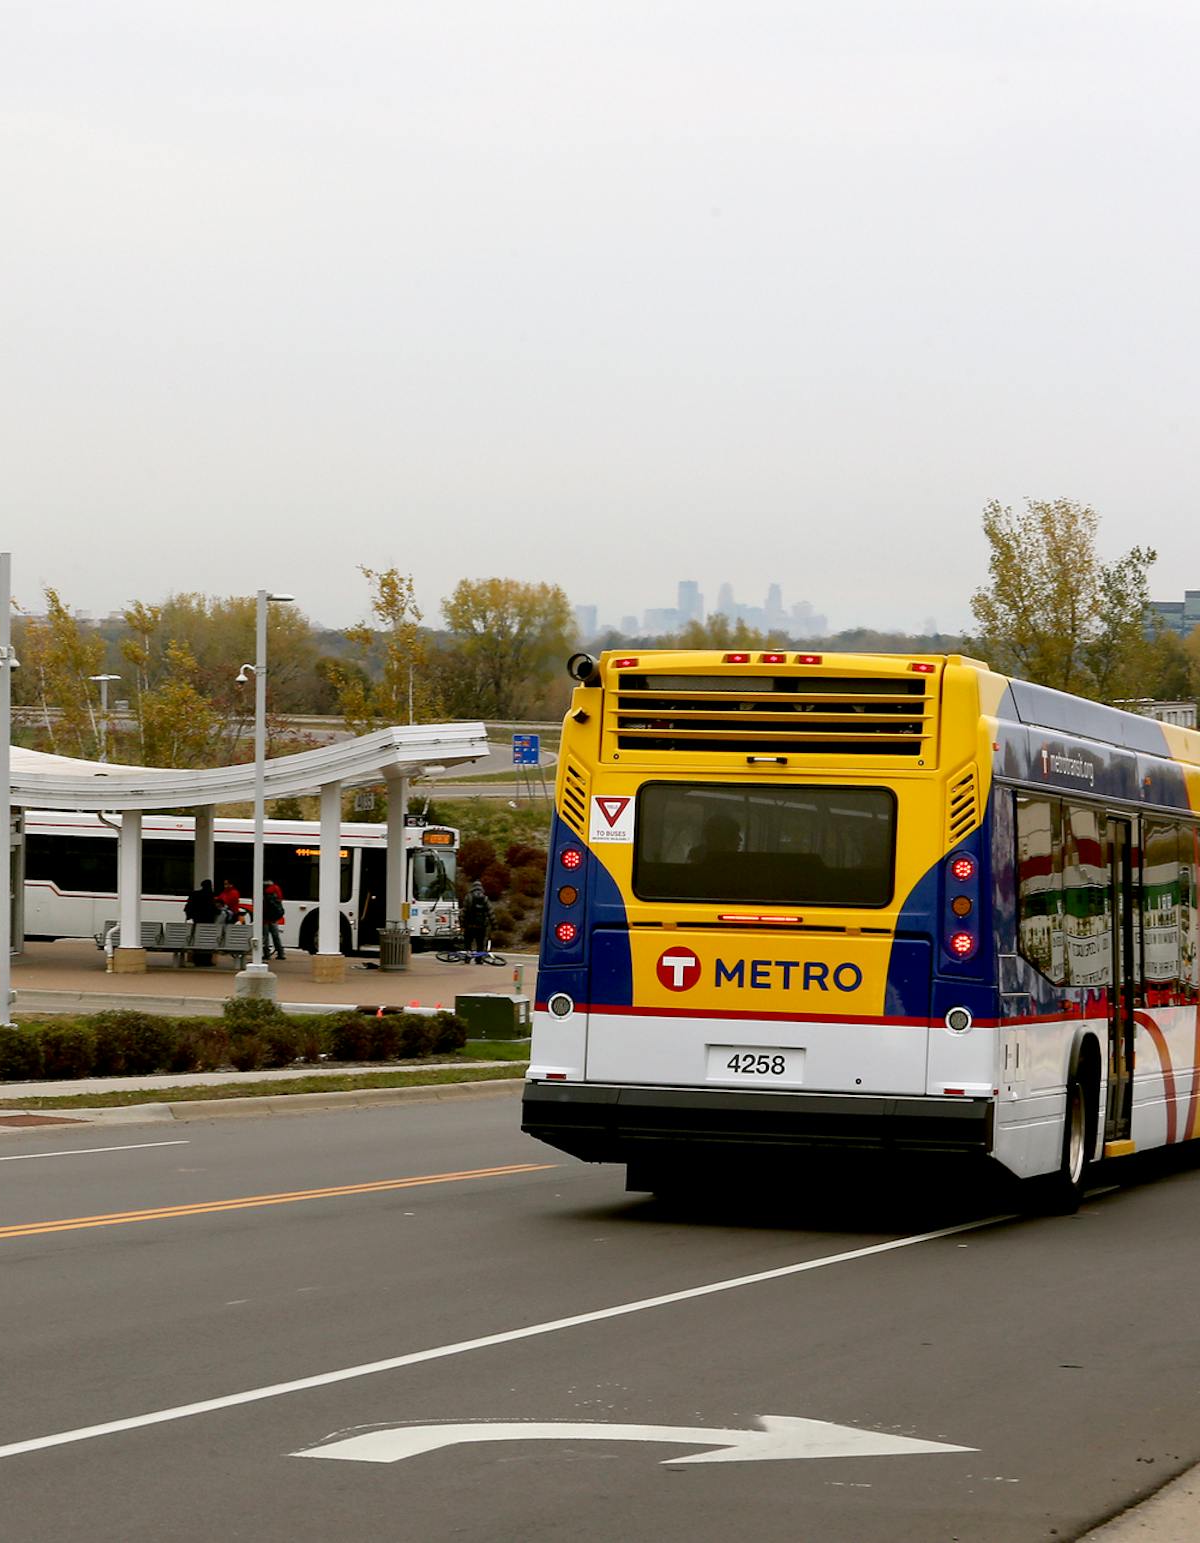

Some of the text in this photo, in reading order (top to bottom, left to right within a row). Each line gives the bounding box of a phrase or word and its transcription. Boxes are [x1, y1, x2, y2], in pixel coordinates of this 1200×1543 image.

[1050, 752, 1094, 787] metrotransit.org
[714, 958, 863, 992] METRO
[727, 1054, 786, 1075] 4258
